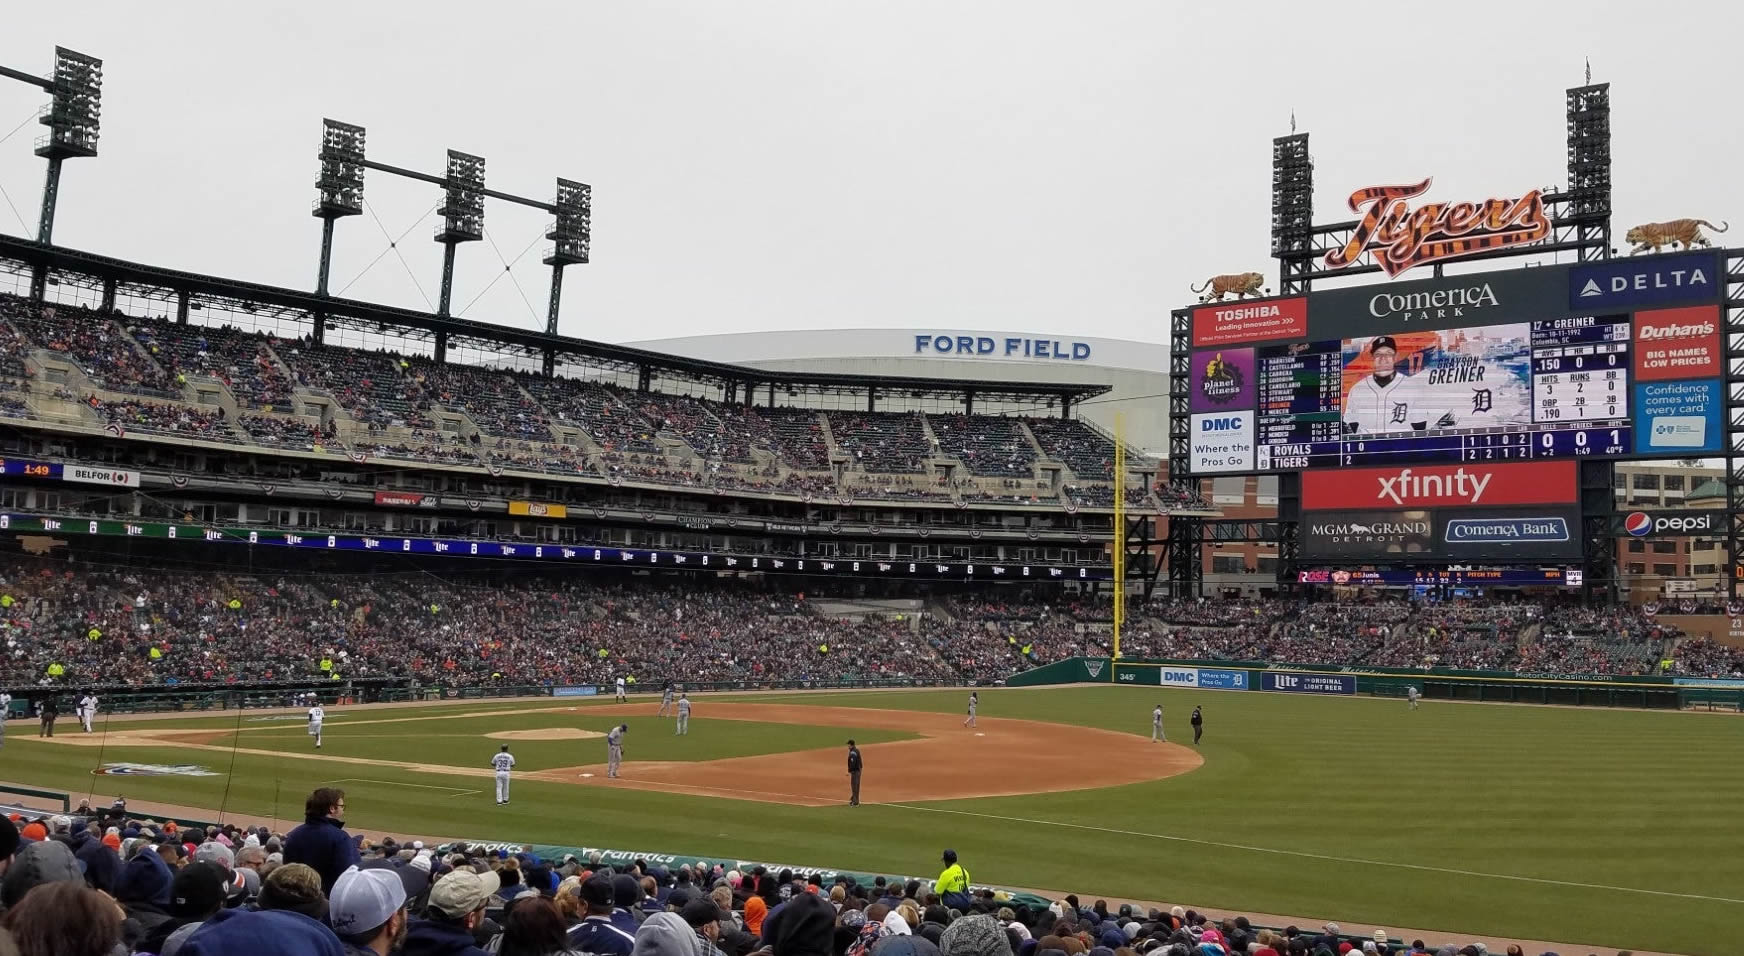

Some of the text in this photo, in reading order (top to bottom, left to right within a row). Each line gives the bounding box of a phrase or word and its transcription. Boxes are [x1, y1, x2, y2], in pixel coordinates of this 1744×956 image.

[1324, 176, 1552, 280] Tigers
[1611, 269, 1707, 292] DELTA
[1216, 305, 1280, 322] TOSHIBA
[1404, 308, 1464, 321] PARK
[1215, 323, 1242, 332] Leading
[1533, 316, 1595, 330] 17 GREINER
[1640, 320, 1715, 339] Dunham's
[914, 335, 1091, 360] FORD FIELD
[1646, 347, 1708, 359] BIG NAMES
[1408, 353, 1424, 375] 17
[1437, 356, 1479, 369] GRAYSON
[1536, 358, 1560, 371] .150
[1575, 357, 1583, 368] 0
[1608, 354, 1616, 366] 0
[1643, 356, 1711, 368] LOW PRICES
[1428, 366, 1486, 385] GREINER
[1570, 373, 1590, 381] RUNS
[1203, 379, 1234, 390] planet
[1547, 385, 1553, 394] 3
[1577, 383, 1583, 392] 2
[1608, 381, 1614, 390] 0
[1645, 384, 1709, 395] Confidence
[1208, 386, 1240, 395] fitness
[1575, 397, 1585, 405] 2B
[1606, 395, 1616, 403] 3B
[1645, 393, 1709, 405] comes with
[1541, 408, 1560, 419] .190
[1579, 407, 1583, 417] 1
[1609, 405, 1615, 415] 0
[1645, 403, 1706, 415] every card.
[1201, 416, 1242, 431] DMC
[1542, 433, 1554, 448] 0
[1575, 431, 1587, 447] 0
[1610, 429, 1619, 445] 1
[1195, 444, 1229, 454] Where
[1231, 442, 1250, 452] the
[1274, 444, 1311, 456] ROYALS
[1346, 443, 1351, 452] 1
[1358, 442, 1364, 451] 0
[1470, 436, 1475, 446] 1
[1486, 435, 1491, 445] 1
[1502, 434, 1509, 444] 0
[1519, 434, 1526, 444] 2
[1549, 448, 1554, 456] 2
[1574, 447, 1591, 455] 1:49
[1201, 456, 1243, 466] Pros Go
[1274, 447, 1526, 468] TIGERS 2 2 2 1 2
[24, 464, 49, 475] 1:49
[75, 470, 110, 481] BELFOR
[1377, 467, 1493, 505] xfinity
[44, 520, 61, 531] Lite
[1311, 521, 1427, 536] MGM GRAND
[1522, 522, 1558, 535] Bank
[1655, 514, 1710, 533] pepsi
[127, 525, 143, 535] Lite
[206, 530, 223, 541] Lite
[286, 534, 303, 545] Lite
[364, 538, 380, 548] Lite
[1332, 535, 1405, 543] DETROIT
[435, 542, 449, 552] Lite
[502, 546, 516, 555] Lite
[563, 549, 576, 558] Lite
[1732, 619, 1742, 628] 23
[1164, 671, 1194, 682] DMC
[1274, 674, 1298, 690] Lite
[1515, 672, 1613, 681] MotorCityCasino.com
